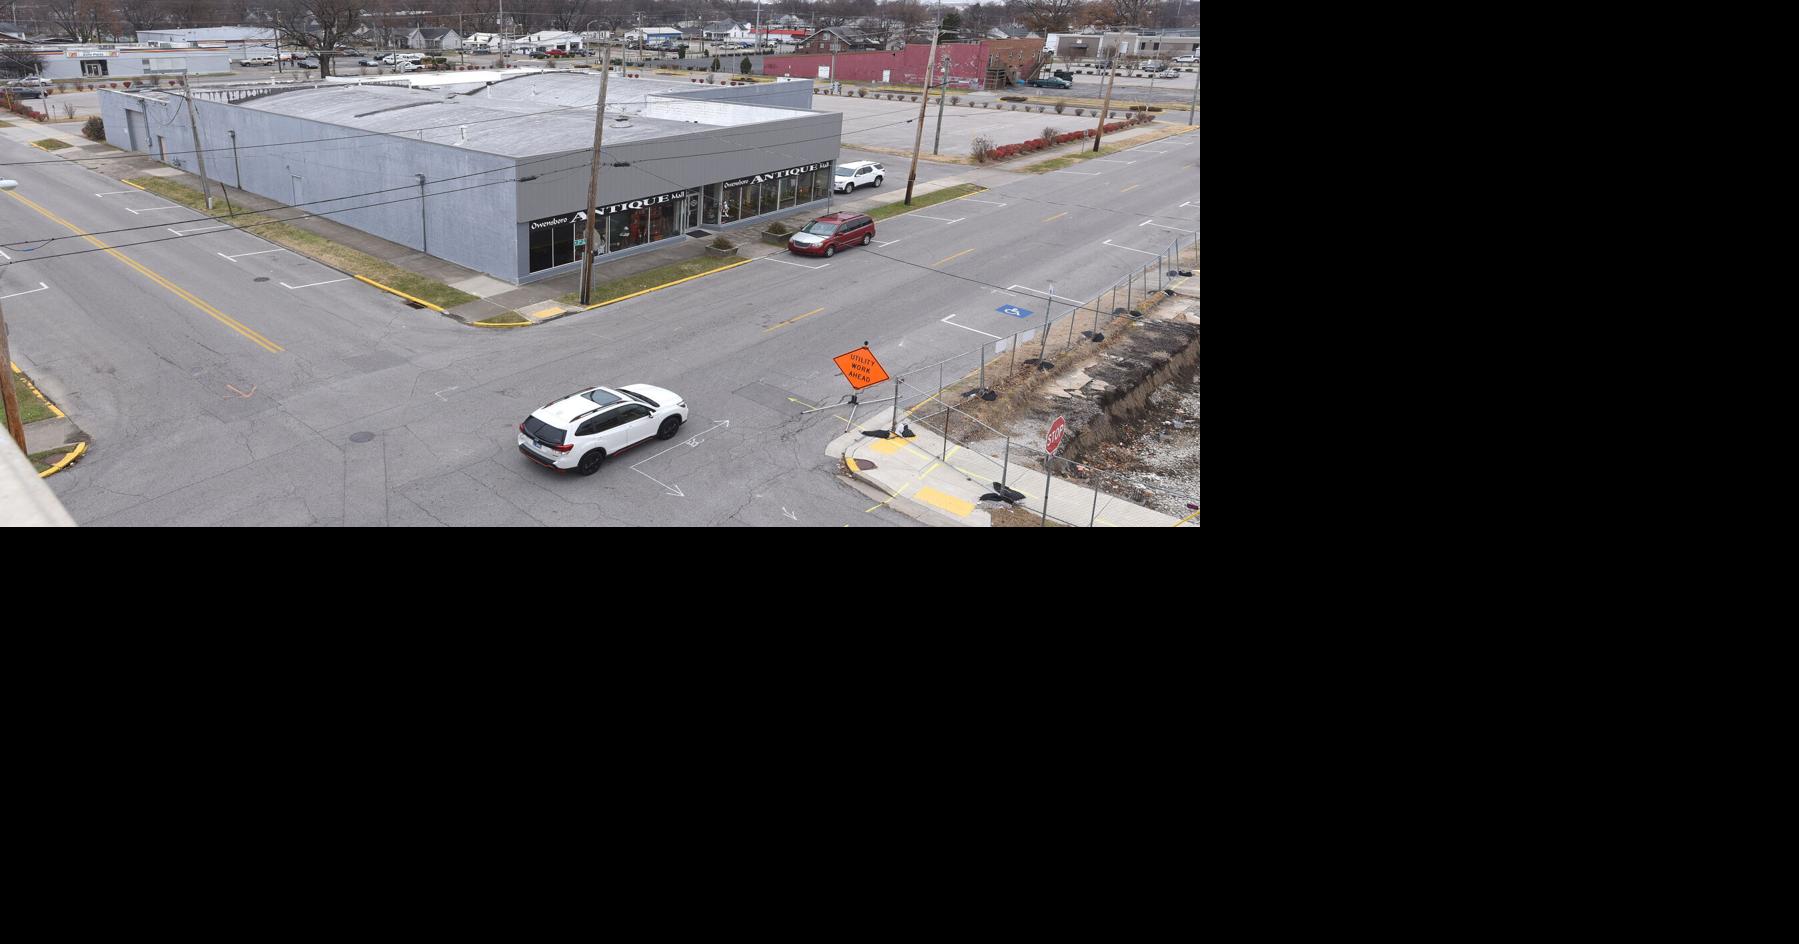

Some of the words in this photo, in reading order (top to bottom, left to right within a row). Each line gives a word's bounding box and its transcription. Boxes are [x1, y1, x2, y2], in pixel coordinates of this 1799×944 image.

[750, 163, 818, 185] ANTIQUE
[531, 217, 568, 229] Owensboro
[850, 354, 876, 367] UTILITY
[851, 363, 871, 374] WORK
[848, 371, 871, 383] AHEAD
[1047, 423, 1064, 446] STOP
